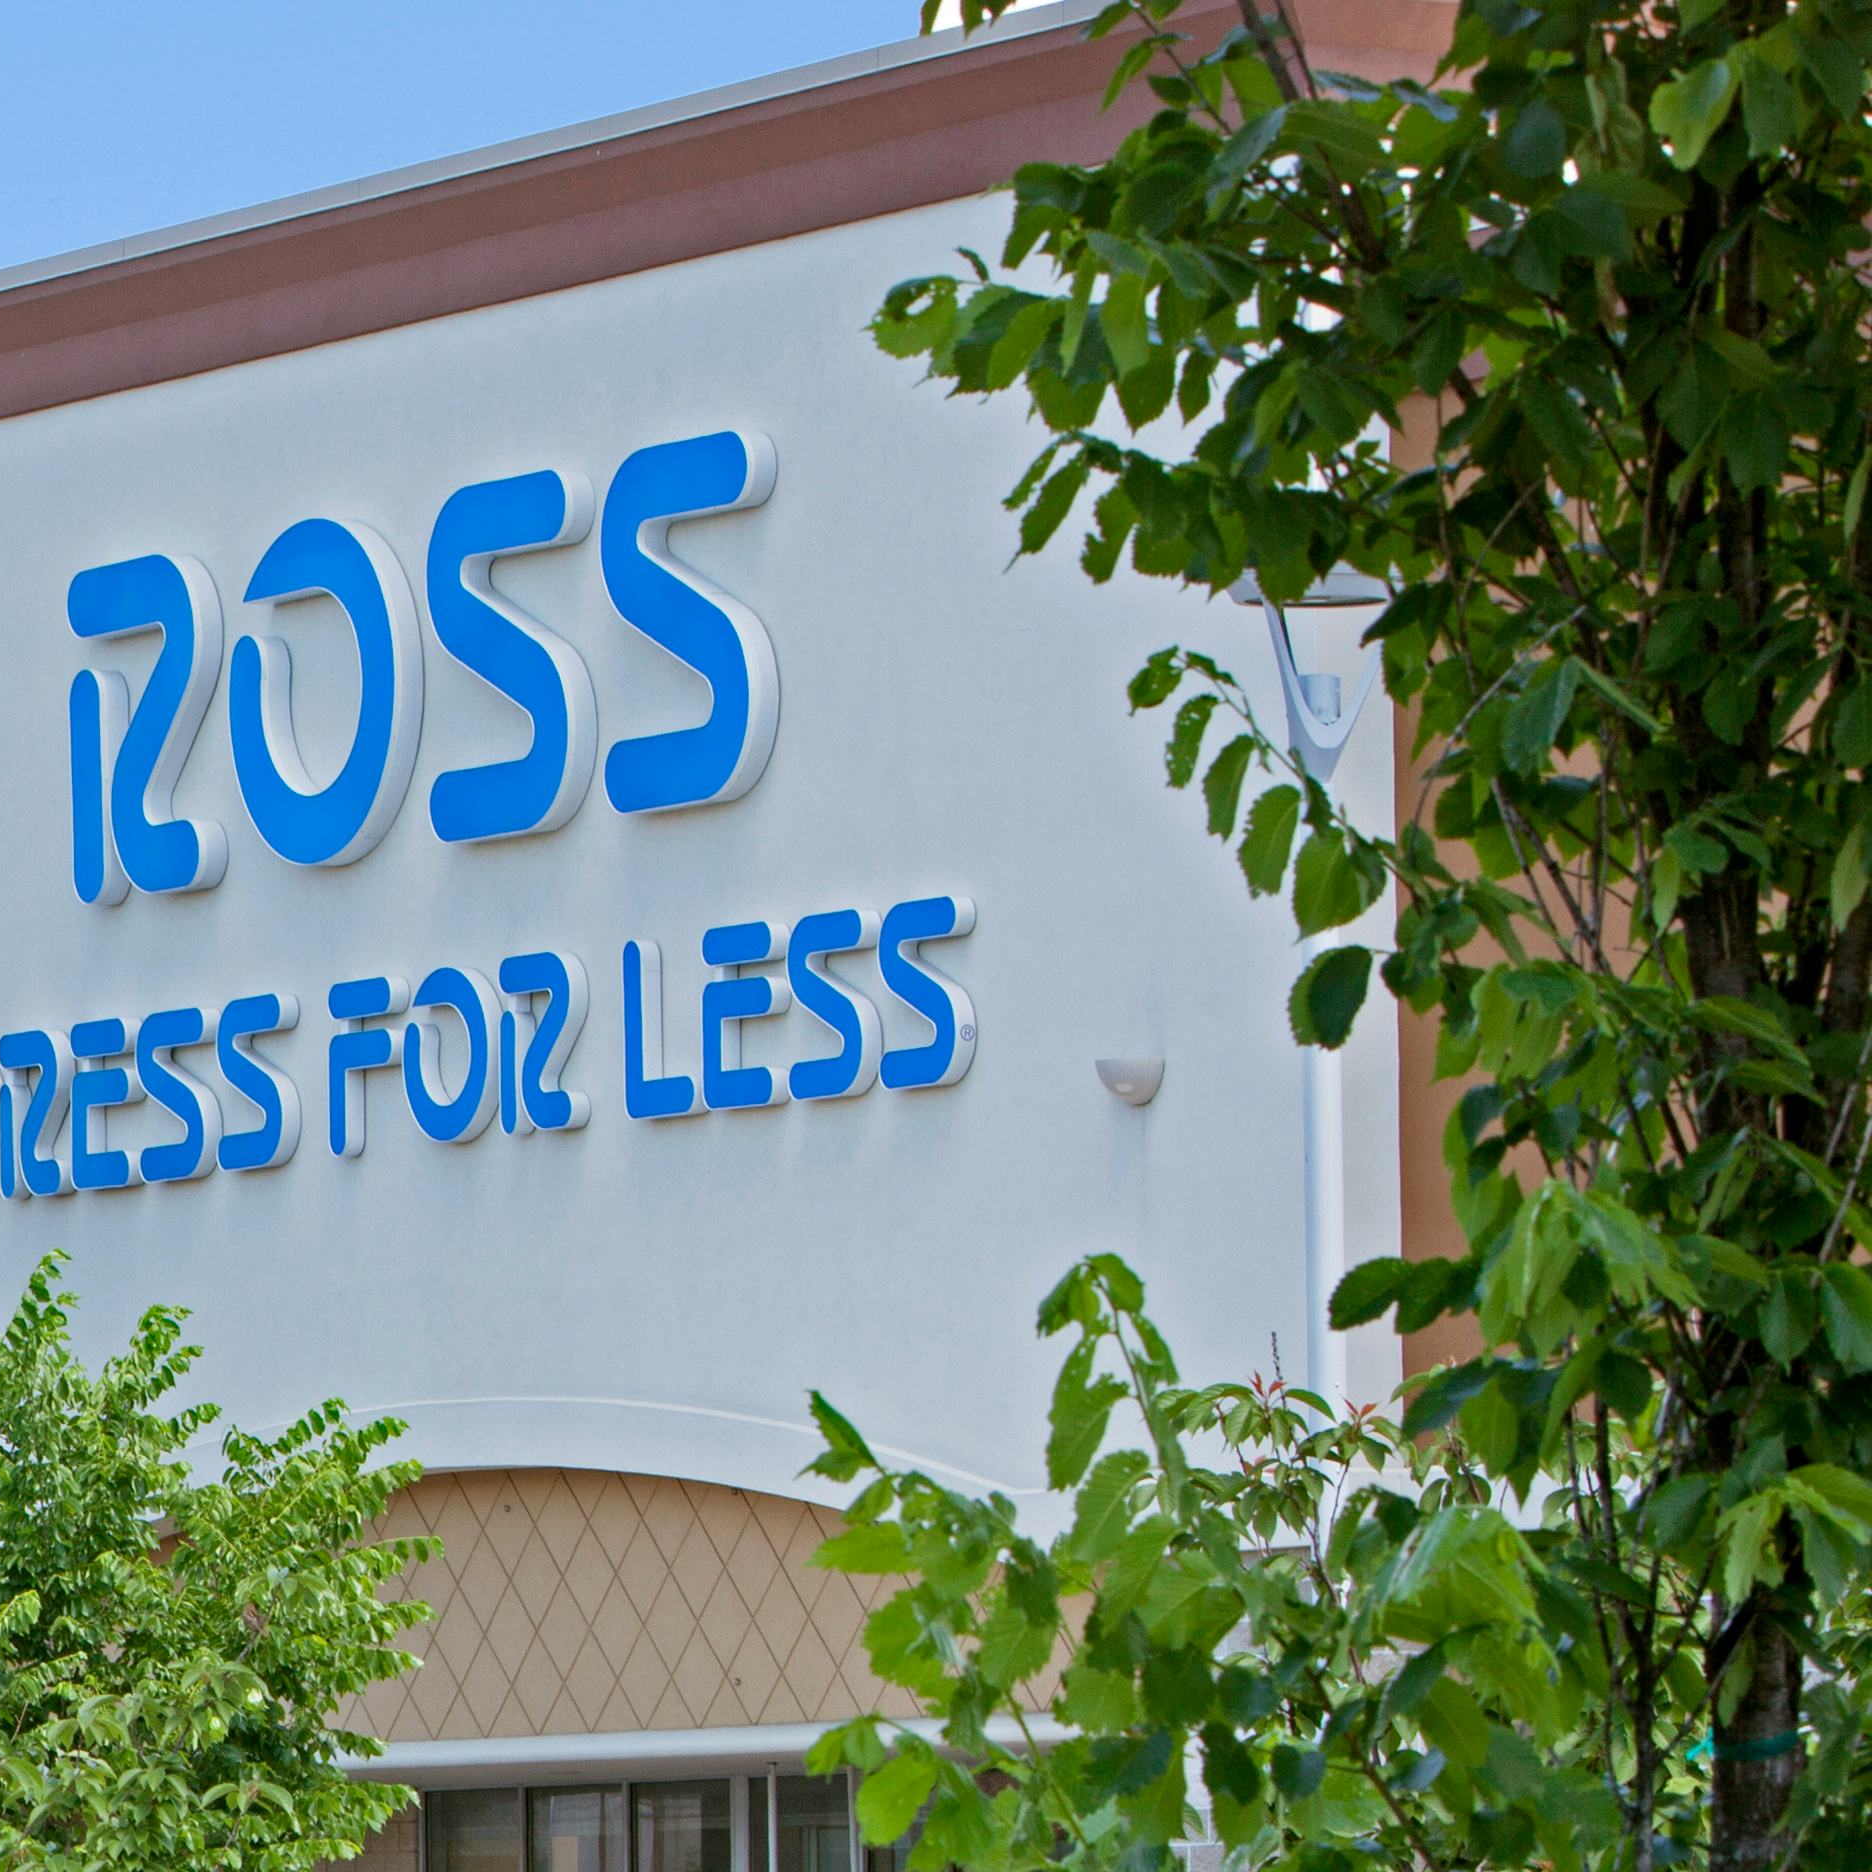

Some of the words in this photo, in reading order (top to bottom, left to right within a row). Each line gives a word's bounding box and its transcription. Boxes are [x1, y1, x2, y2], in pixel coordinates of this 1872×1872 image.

[67, 428, 774, 905] ROSS
[328, 951, 588, 1156] FOR
[623, 895, 974, 1119] LESS
